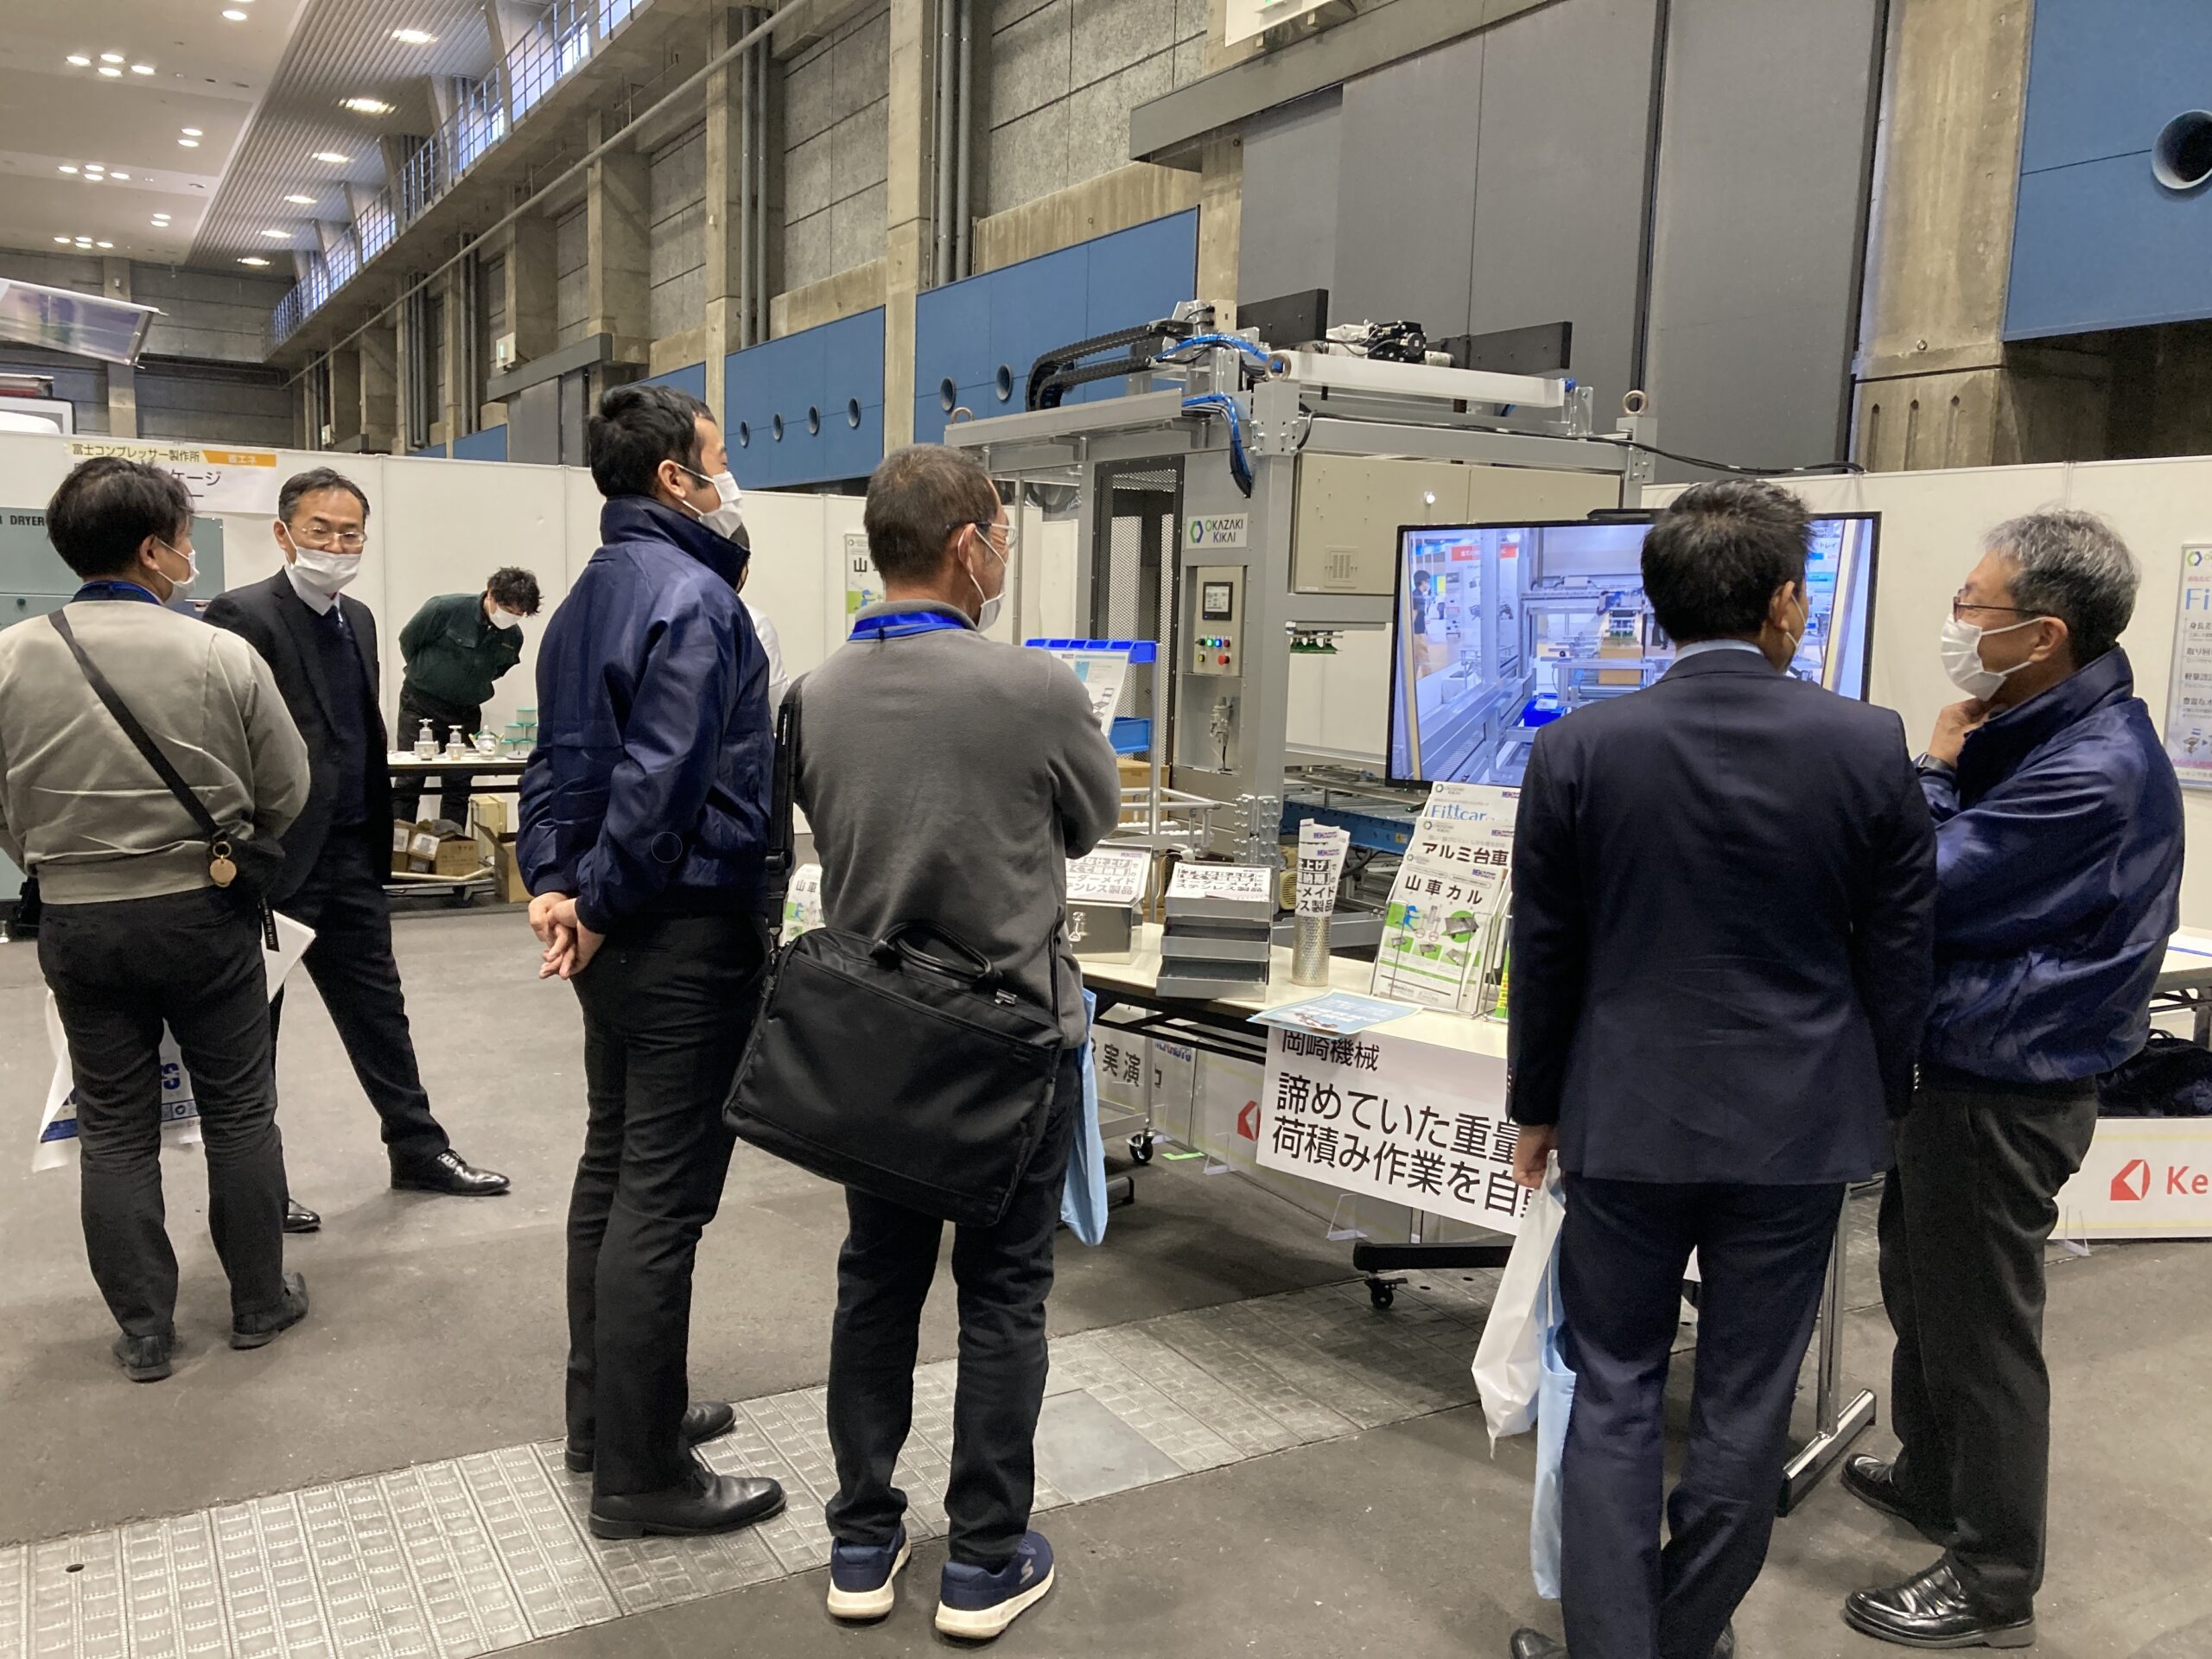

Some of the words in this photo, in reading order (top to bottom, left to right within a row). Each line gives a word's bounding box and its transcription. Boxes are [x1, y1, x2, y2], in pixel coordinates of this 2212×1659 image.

[10, 515, 44, 526] DRYER
[1205, 519, 1243, 532] OKAZAKI
[1213, 531, 1236, 543] KIKAI
[1422, 842, 1509, 867] アルミ台車
[1405, 874, 1483, 905] 山車カル
[1295, 899, 1333, 912] ス製品
[1281, 1030, 1380, 1071] 岡崎機械
[1276, 1071, 1521, 1166] 諦めていた重量
[2166, 1166, 2209, 1195] Ke
